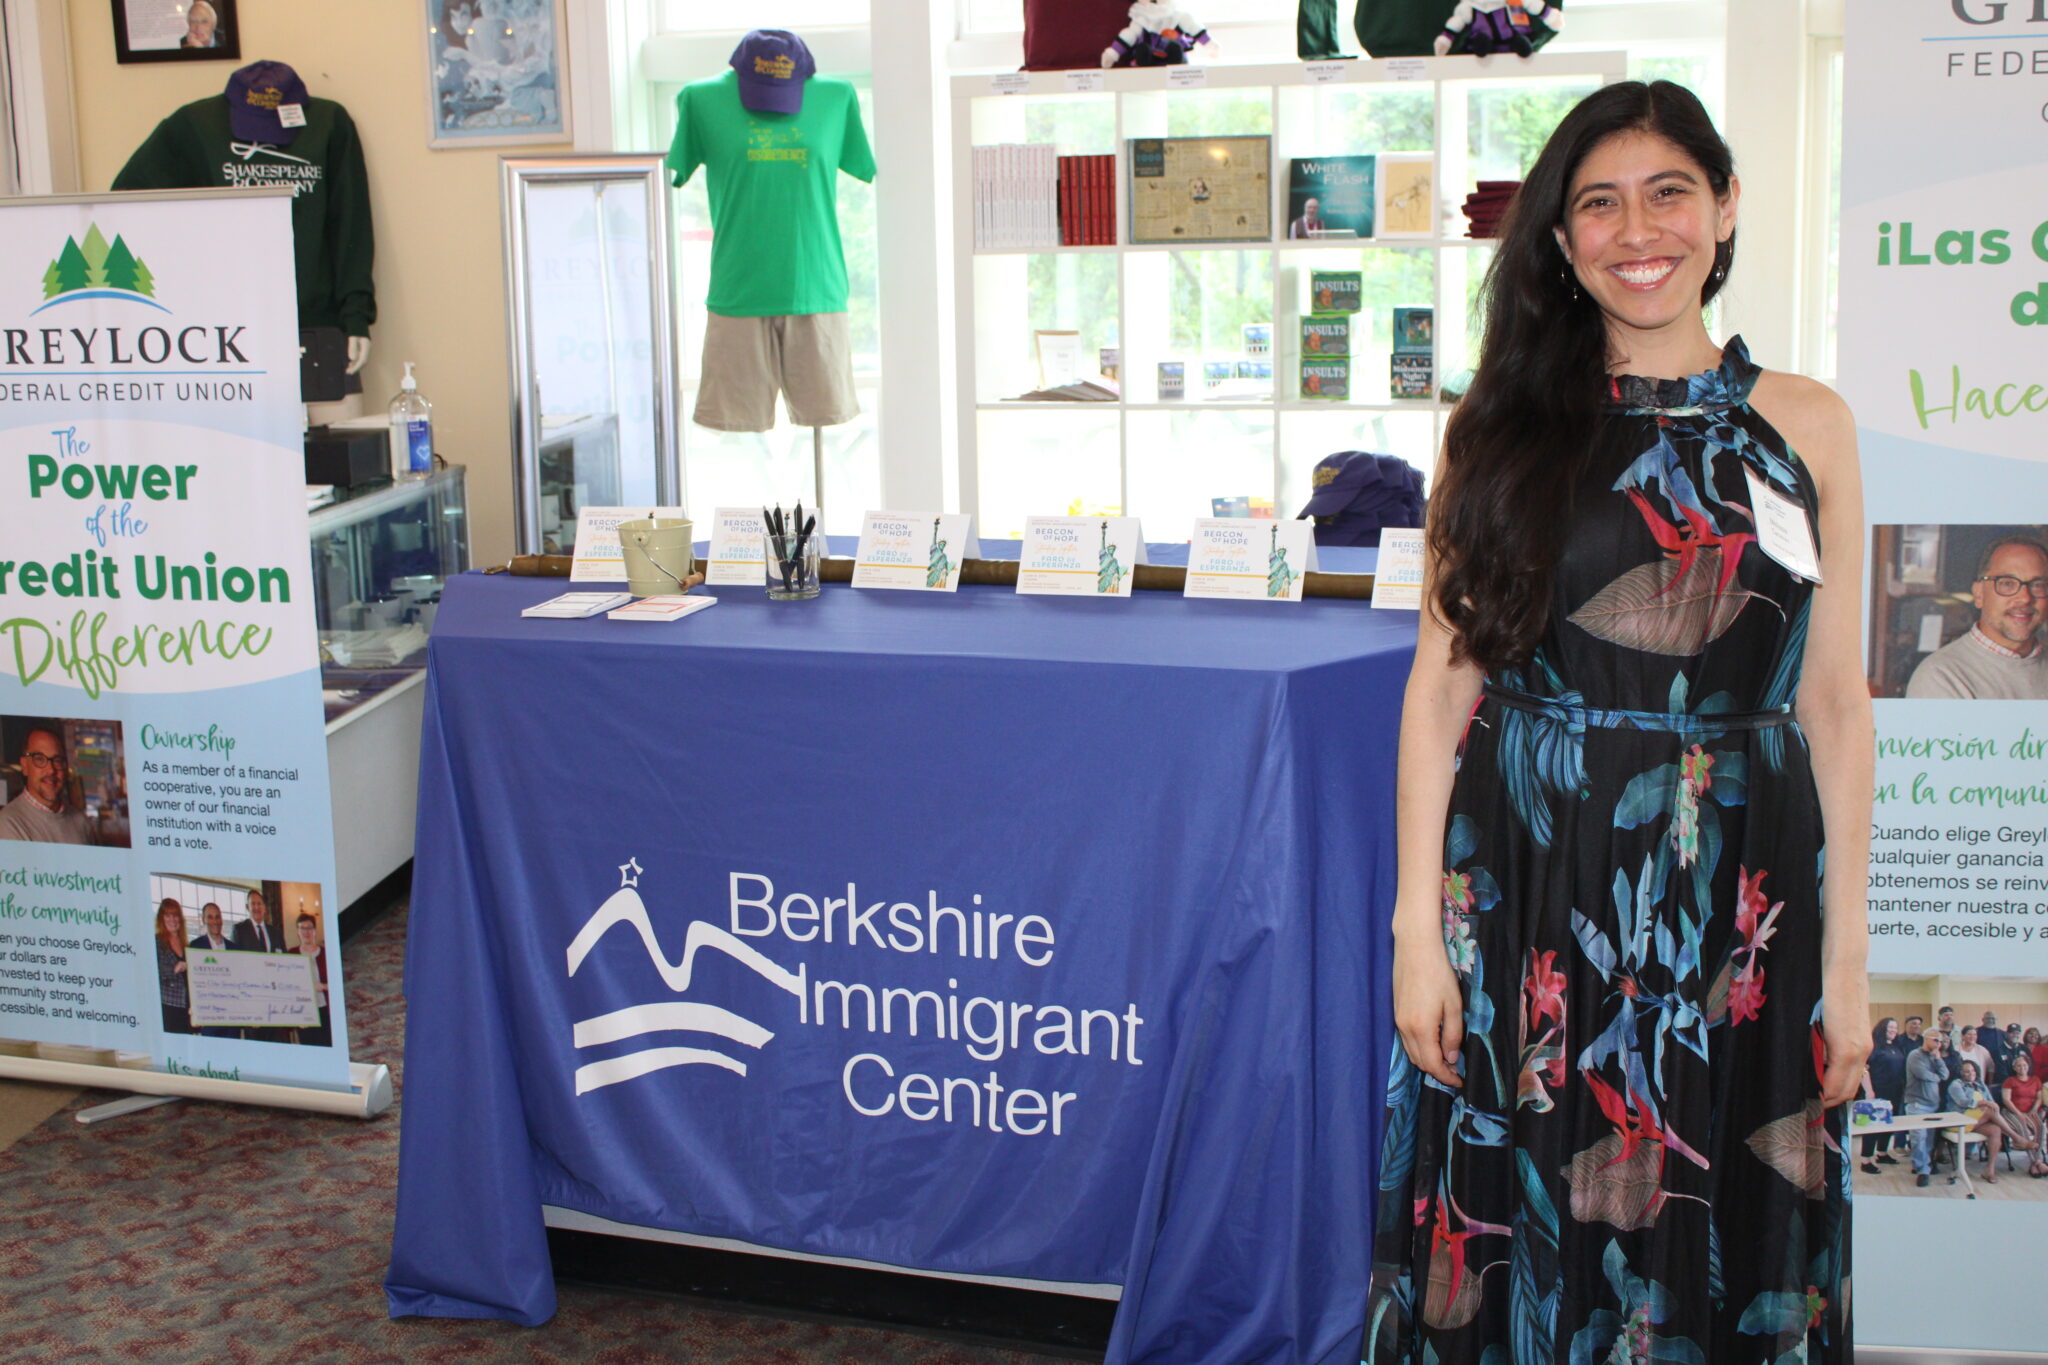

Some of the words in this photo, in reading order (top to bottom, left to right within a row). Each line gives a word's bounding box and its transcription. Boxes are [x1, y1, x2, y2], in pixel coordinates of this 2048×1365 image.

[222, 162, 322, 179] SHAKESPEARE
[1302, 163, 1347, 174] WHITE
[1324, 174, 1369, 185] FLASH
[1315, 280, 1360, 292] INSULTS
[1303, 324, 1347, 336] INSULTS
[3, 326, 249, 365] REYLOCK
[1303, 366, 1346, 377] INSULTS
[78, 383, 165, 401] CREDIT
[176, 382, 253, 401] UNION
[52, 426, 90, 458] The
[28, 454, 198, 501] Power
[86, 504, 107, 548] of
[111, 502, 148, 538] the
[872, 522, 908, 530] BEACON
[1203, 530, 1243, 538] BEACON
[0, 549, 121, 599] redit
[134, 551, 291, 604] Union
[0, 609, 273, 701] Difference
[141, 723, 236, 761] Ownership
[1874, 728, 1997, 761] nversión
[142, 760, 159, 774] As
[162, 764, 169, 774] a
[172, 762, 220, 777] member
[223, 765, 235, 777] of
[238, 767, 246, 778] a
[249, 766, 299, 781] financial
[143, 780, 216, 797] cooperative,
[219, 785, 241, 799] you
[244, 787, 263, 798] are
[265, 787, 281, 799] an
[1911, 772, 1938, 805] la
[145, 800, 181, 812] owner
[184, 801, 196, 813] of
[198, 802, 219, 814] our
[222, 801, 271, 817] financial
[146, 816, 202, 831] institution
[205, 819, 232, 833] with
[235, 822, 243, 834] a
[245, 822, 277, 836] voice
[1946, 826, 1991, 845] elige
[148, 834, 171, 848] and
[174, 836, 182, 848] a
[184, 838, 213, 850] vote.
[1956, 851, 2044, 870] ganancia
[33, 867, 122, 894] investment
[1975, 878, 1999, 891] se
[0, 892, 27, 920] the
[31, 905, 121, 936] community
[1957, 900, 2029, 915] nuestra
[729, 871, 1055, 967] Berkshire
[1926, 922, 2017, 938] accesible
[2022, 926, 2034, 942] y
[15, 935, 36, 948] you
[39, 935, 81, 950] choose
[82, 938, 137, 957] Greylock,
[10, 950, 47, 964] dollars
[49, 955, 68, 966] are
[43, 970, 55, 983] to
[58, 972, 86, 987] keep
[88, 976, 114, 989] your
[49, 988, 89, 1005] strong,
[51, 1006, 73, 1019] and
[76, 1009, 141, 1028] welcoming.
[799, 962, 1144, 1066] Immigrant
[842, 1053, 1077, 1136] Center
